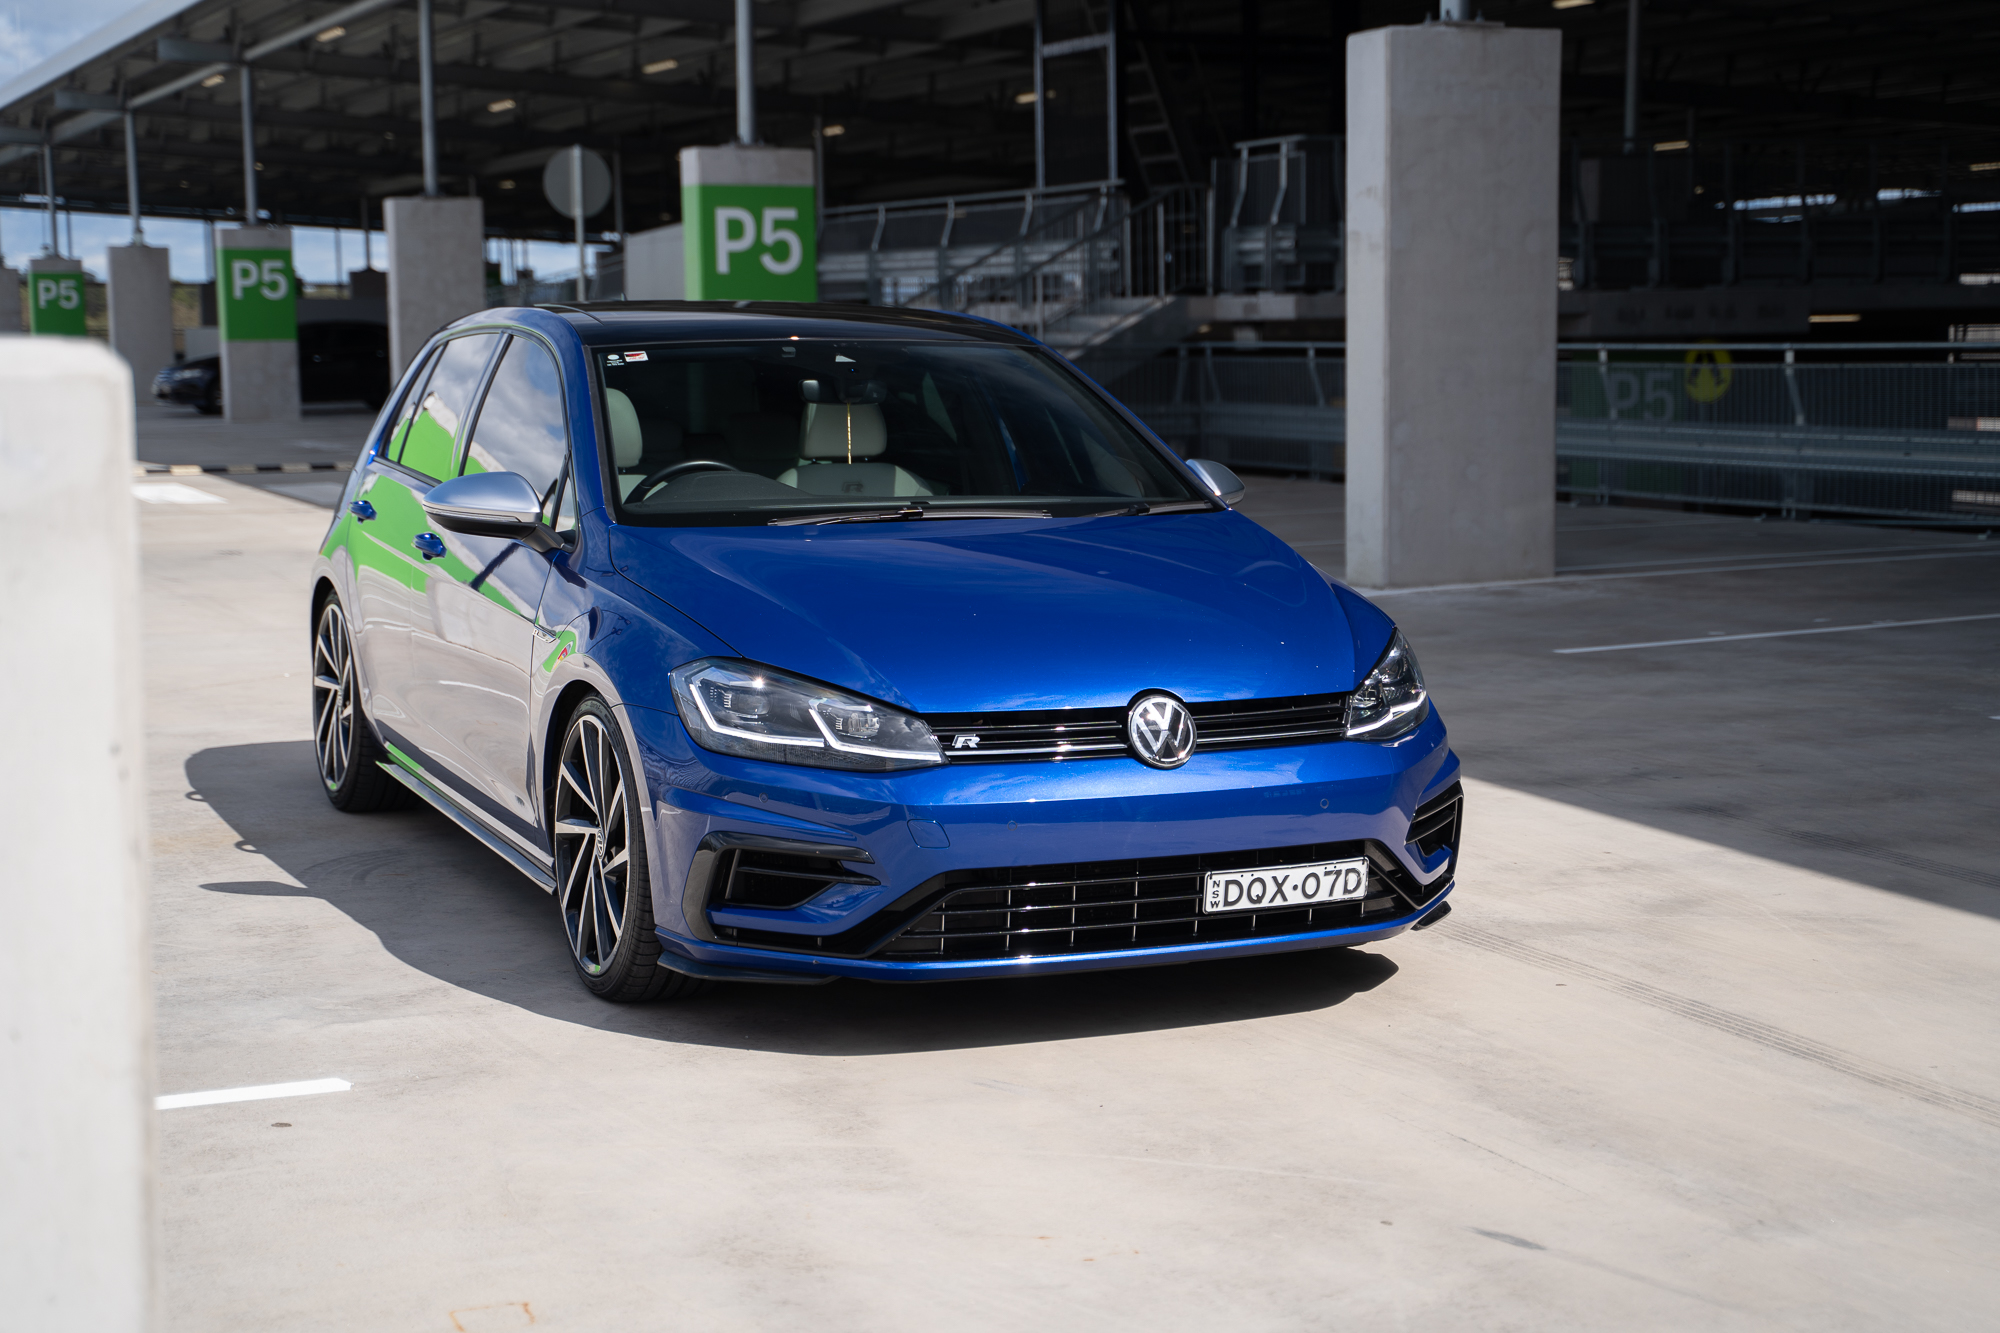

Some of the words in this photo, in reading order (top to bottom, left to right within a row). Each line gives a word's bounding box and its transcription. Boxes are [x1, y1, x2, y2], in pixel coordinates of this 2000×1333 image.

[714, 206, 803, 275] P5
[37, 278, 80, 309] P5
[231, 258, 289, 300] P5
[1609, 370, 1675, 422] P5
[952, 734, 980, 748] R
[1131, 697, 1194, 763] VW
[1210, 879, 1220, 909] NSW
